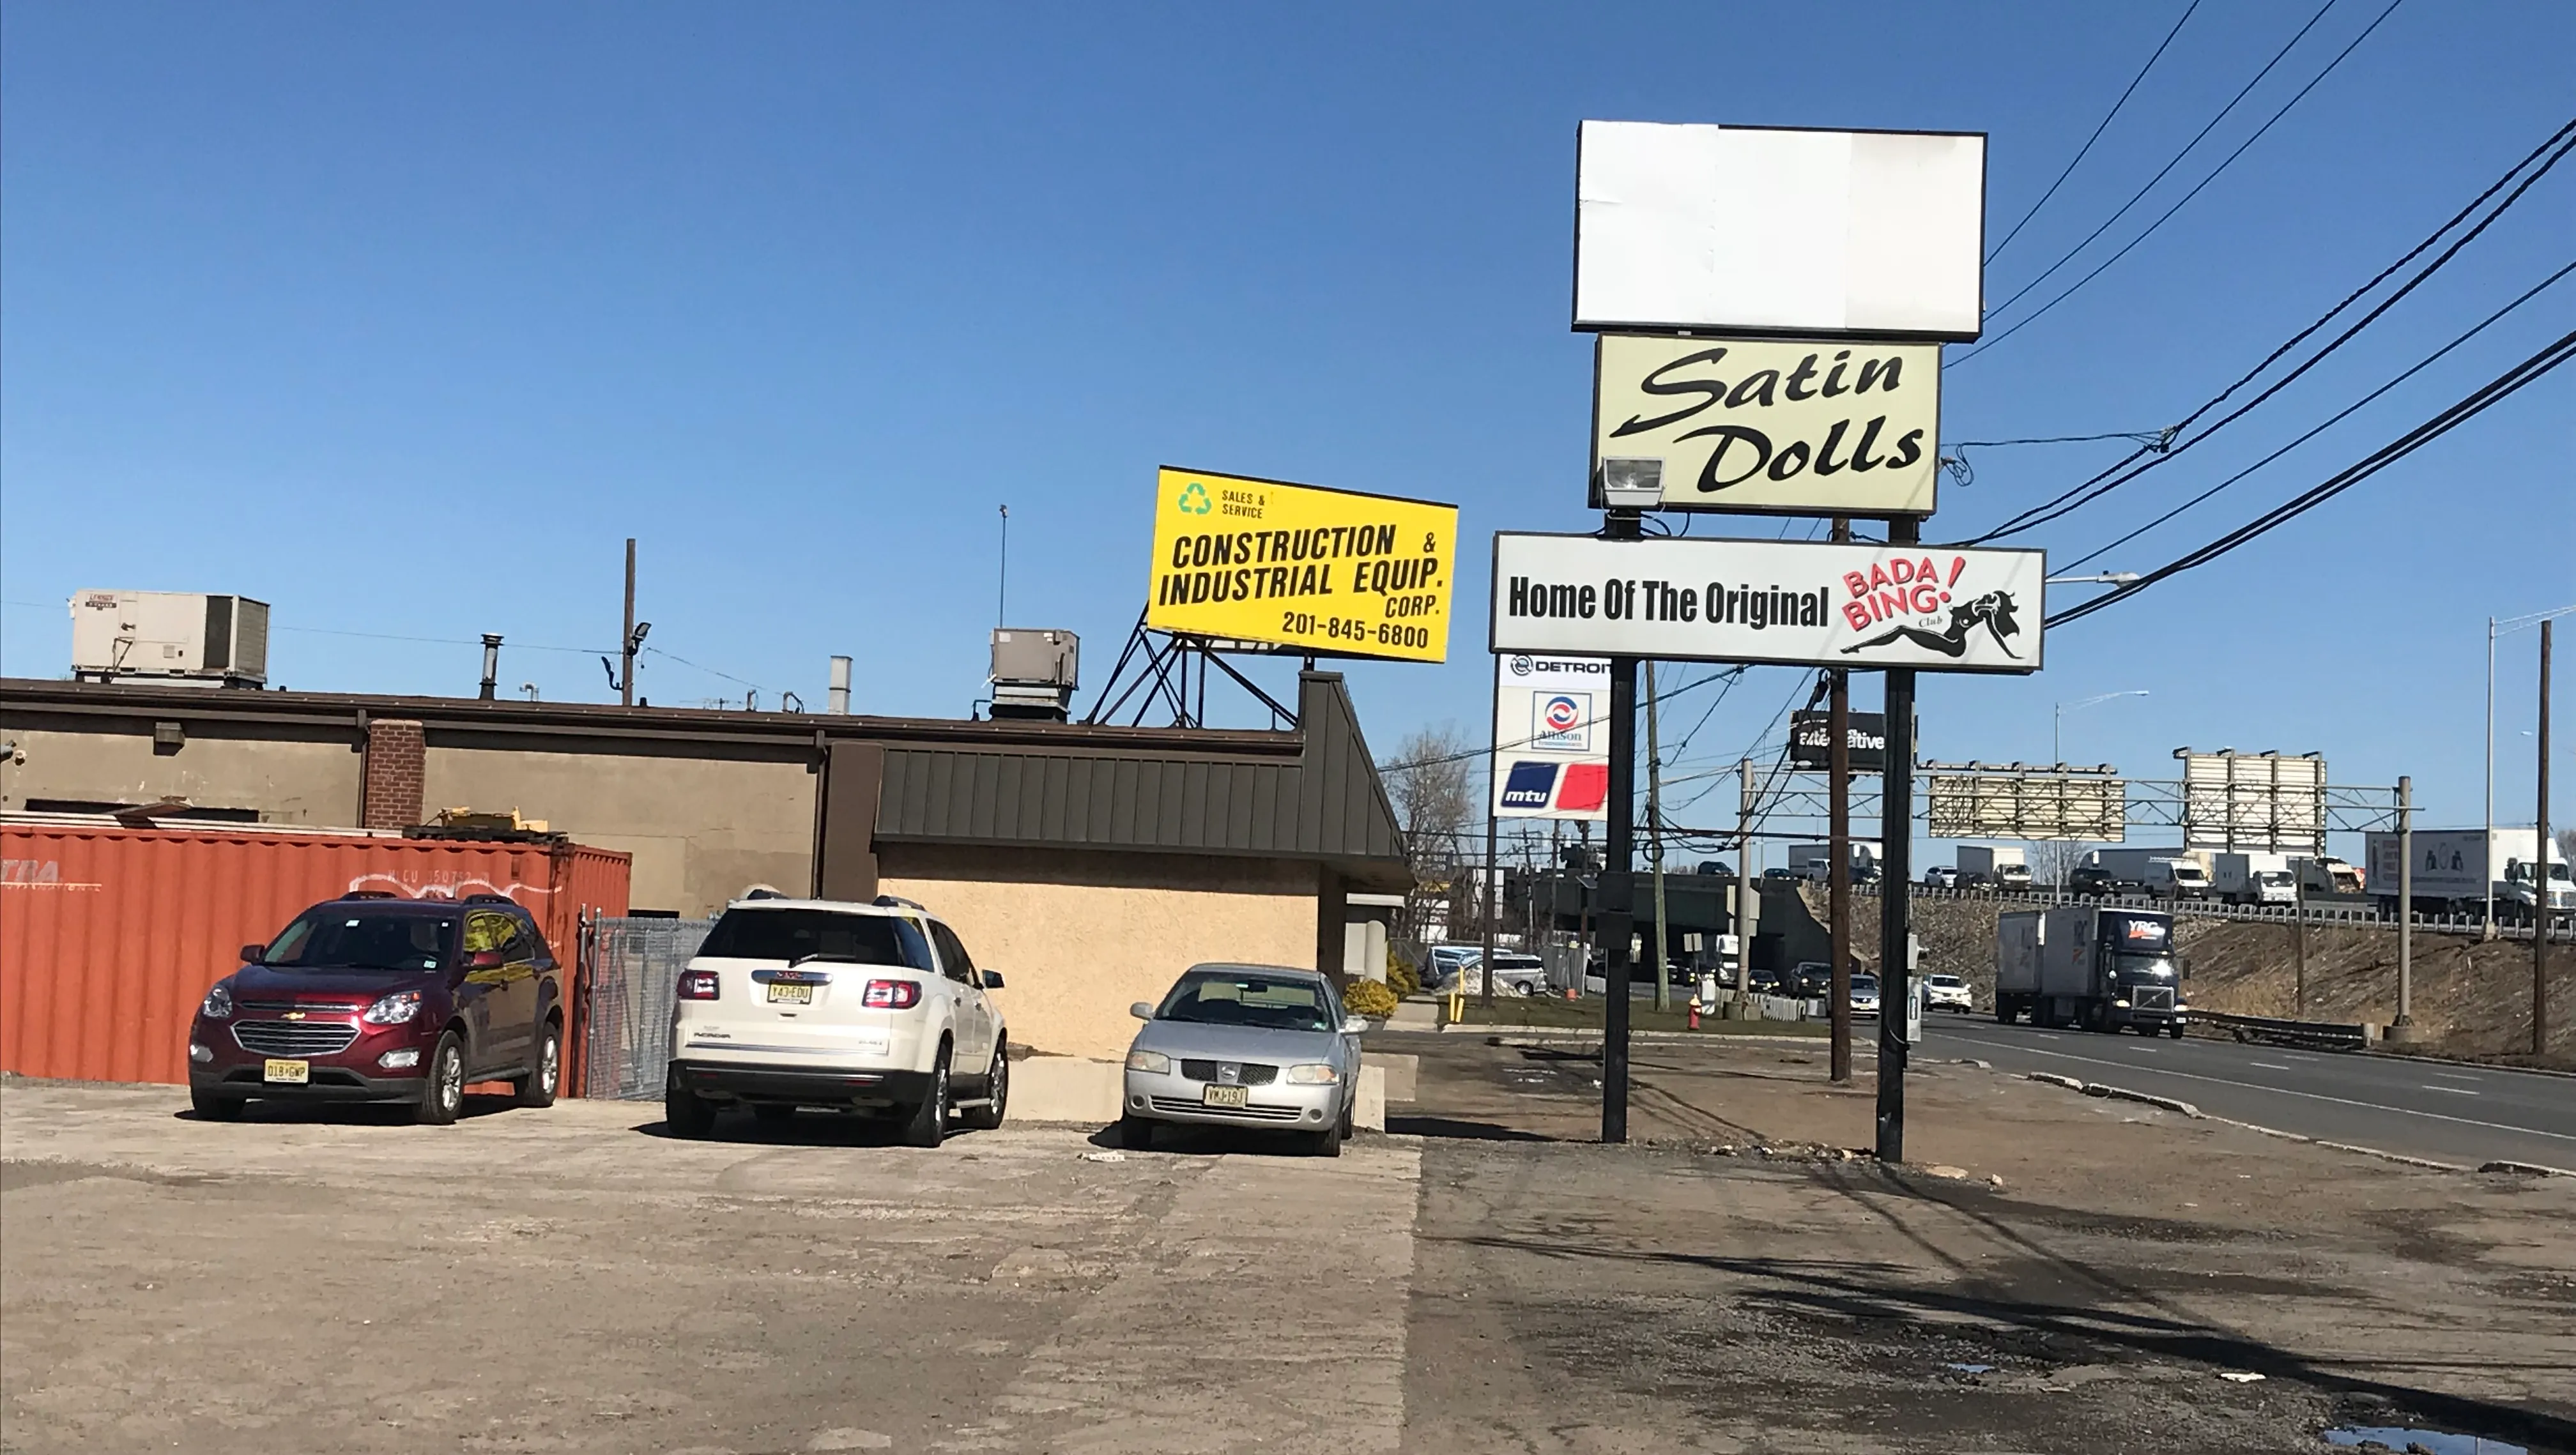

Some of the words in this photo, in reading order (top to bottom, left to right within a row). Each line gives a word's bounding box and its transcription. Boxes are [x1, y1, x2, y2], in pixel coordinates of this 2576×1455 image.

[1609, 347, 1903, 438] Satin
[1673, 416, 1924, 492] Dolls
[1222, 489, 1253, 504] SALES
[1258, 495, 1265, 506] &
[1222, 503, 1262, 519] SERVICE
[1172, 524, 1397, 568] CONSTRUCTION
[1423, 532, 1436, 553] &
[1158, 564, 1333, 606] INDUSTRIAL
[1353, 558, 1443, 597] EQUIP.
[1843, 557, 1939, 598] BADA
[1385, 595, 1440, 618] CORP.
[1509, 576, 1596, 619] Home
[1605, 578, 1636, 620] Of
[1642, 580, 1698, 622] The
[1706, 582, 1829, 630] Original
[1919, 616, 1943, 627] Club
[1282, 611, 1429, 648] 201-845-6800
[1505, 790, 1547, 803] mtu
